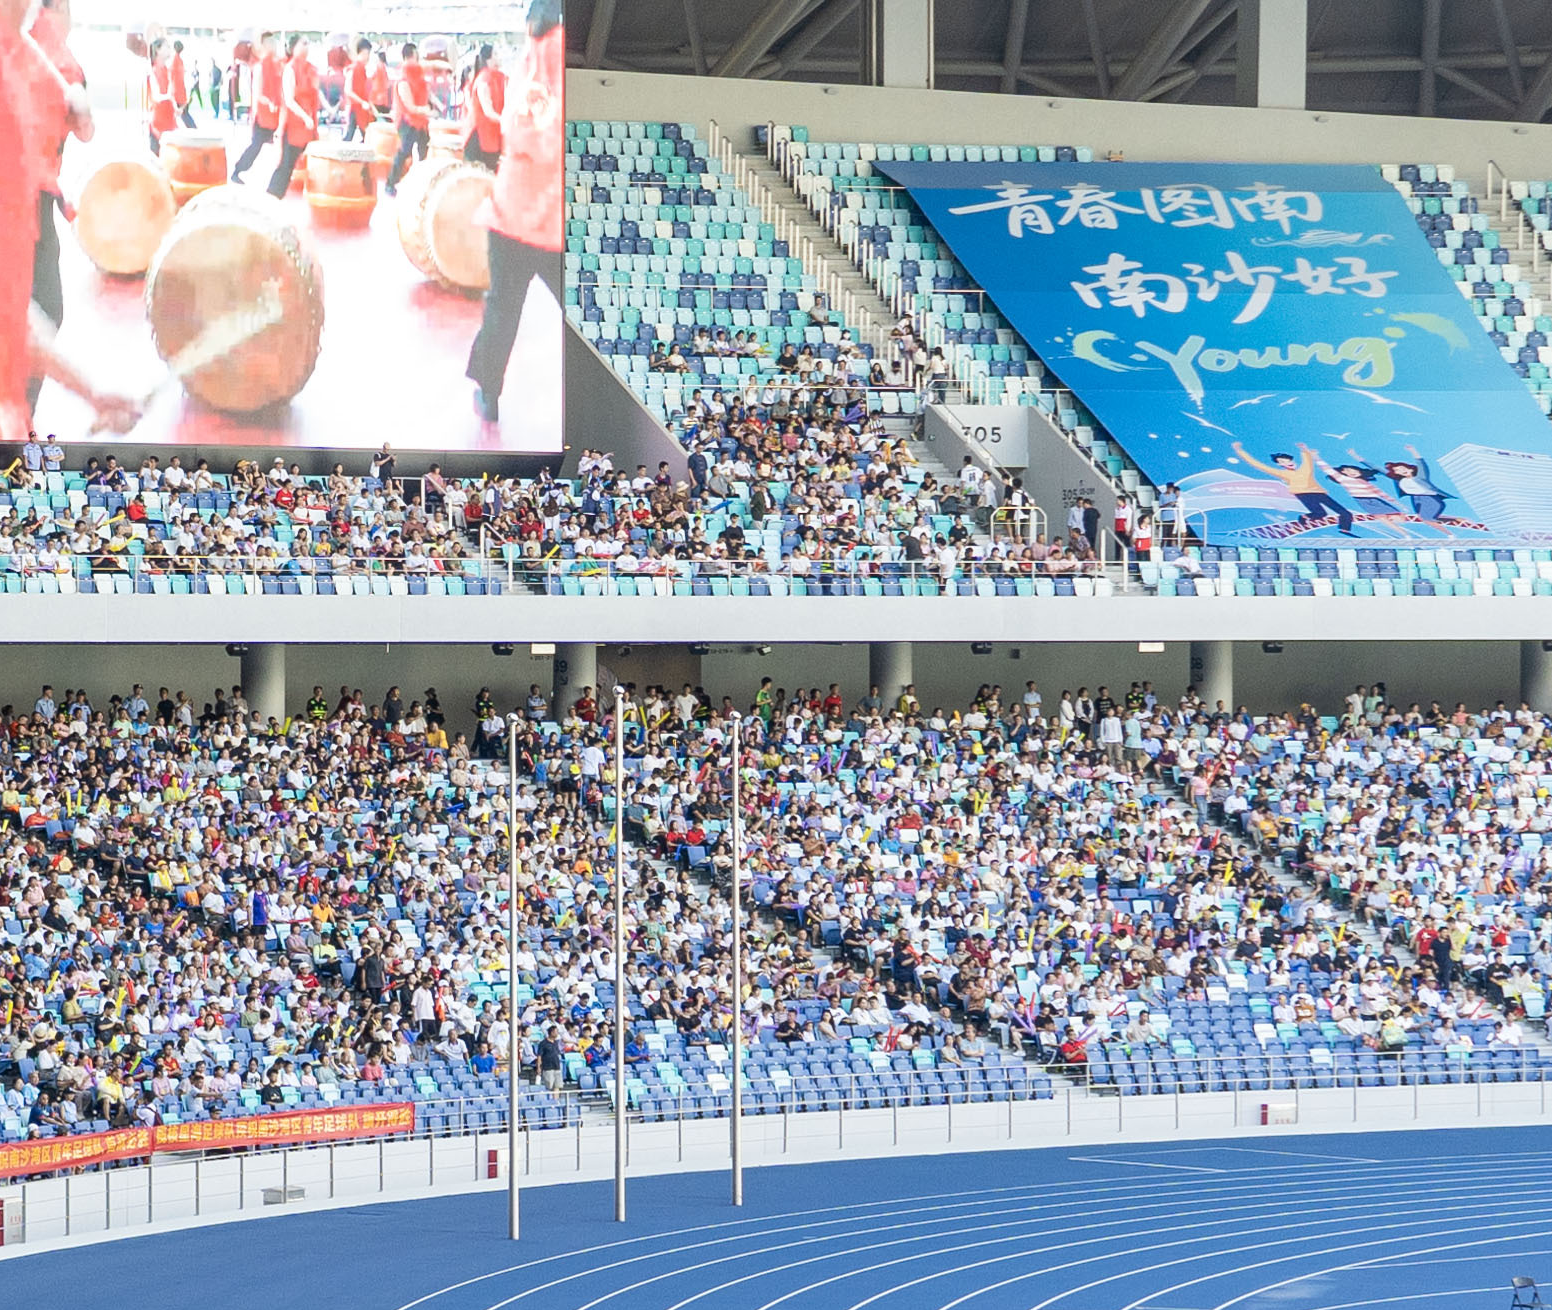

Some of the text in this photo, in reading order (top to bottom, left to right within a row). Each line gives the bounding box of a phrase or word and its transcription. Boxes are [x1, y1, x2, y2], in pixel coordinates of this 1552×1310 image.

[949, 182, 1322, 238] 青春图南
[1071, 251, 1399, 324] 南沙好
